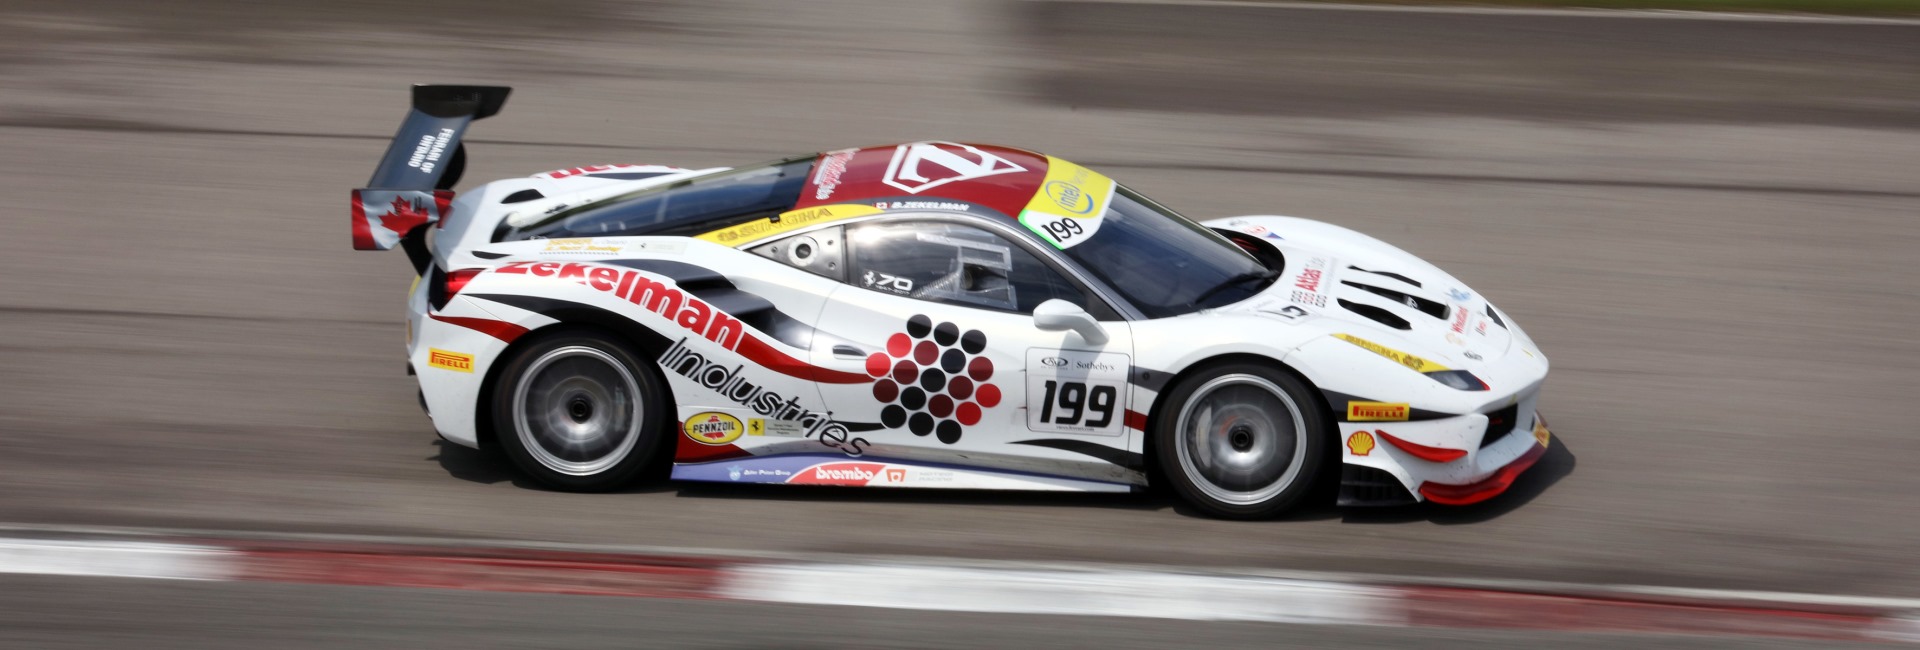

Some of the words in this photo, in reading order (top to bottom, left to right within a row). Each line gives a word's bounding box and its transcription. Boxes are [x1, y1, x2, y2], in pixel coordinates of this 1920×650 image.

[408, 135, 436, 168] ONTARIO
[426, 128, 455, 161] FERRARI
[420, 162, 435, 174] OF
[1041, 217, 1083, 243] 199
[877, 274, 913, 292] 70
[1295, 268, 1322, 292] Atlas
[431, 351, 470, 370] PIRELLI
[1076, 360, 1115, 372] Sotheby's
[656, 336, 872, 458] Industries
[1040, 380, 1117, 428] 199
[1353, 405, 1404, 418] PIRELLI
[692, 420, 736, 434] PENNZOIL
[815, 465, 874, 481] brembo
